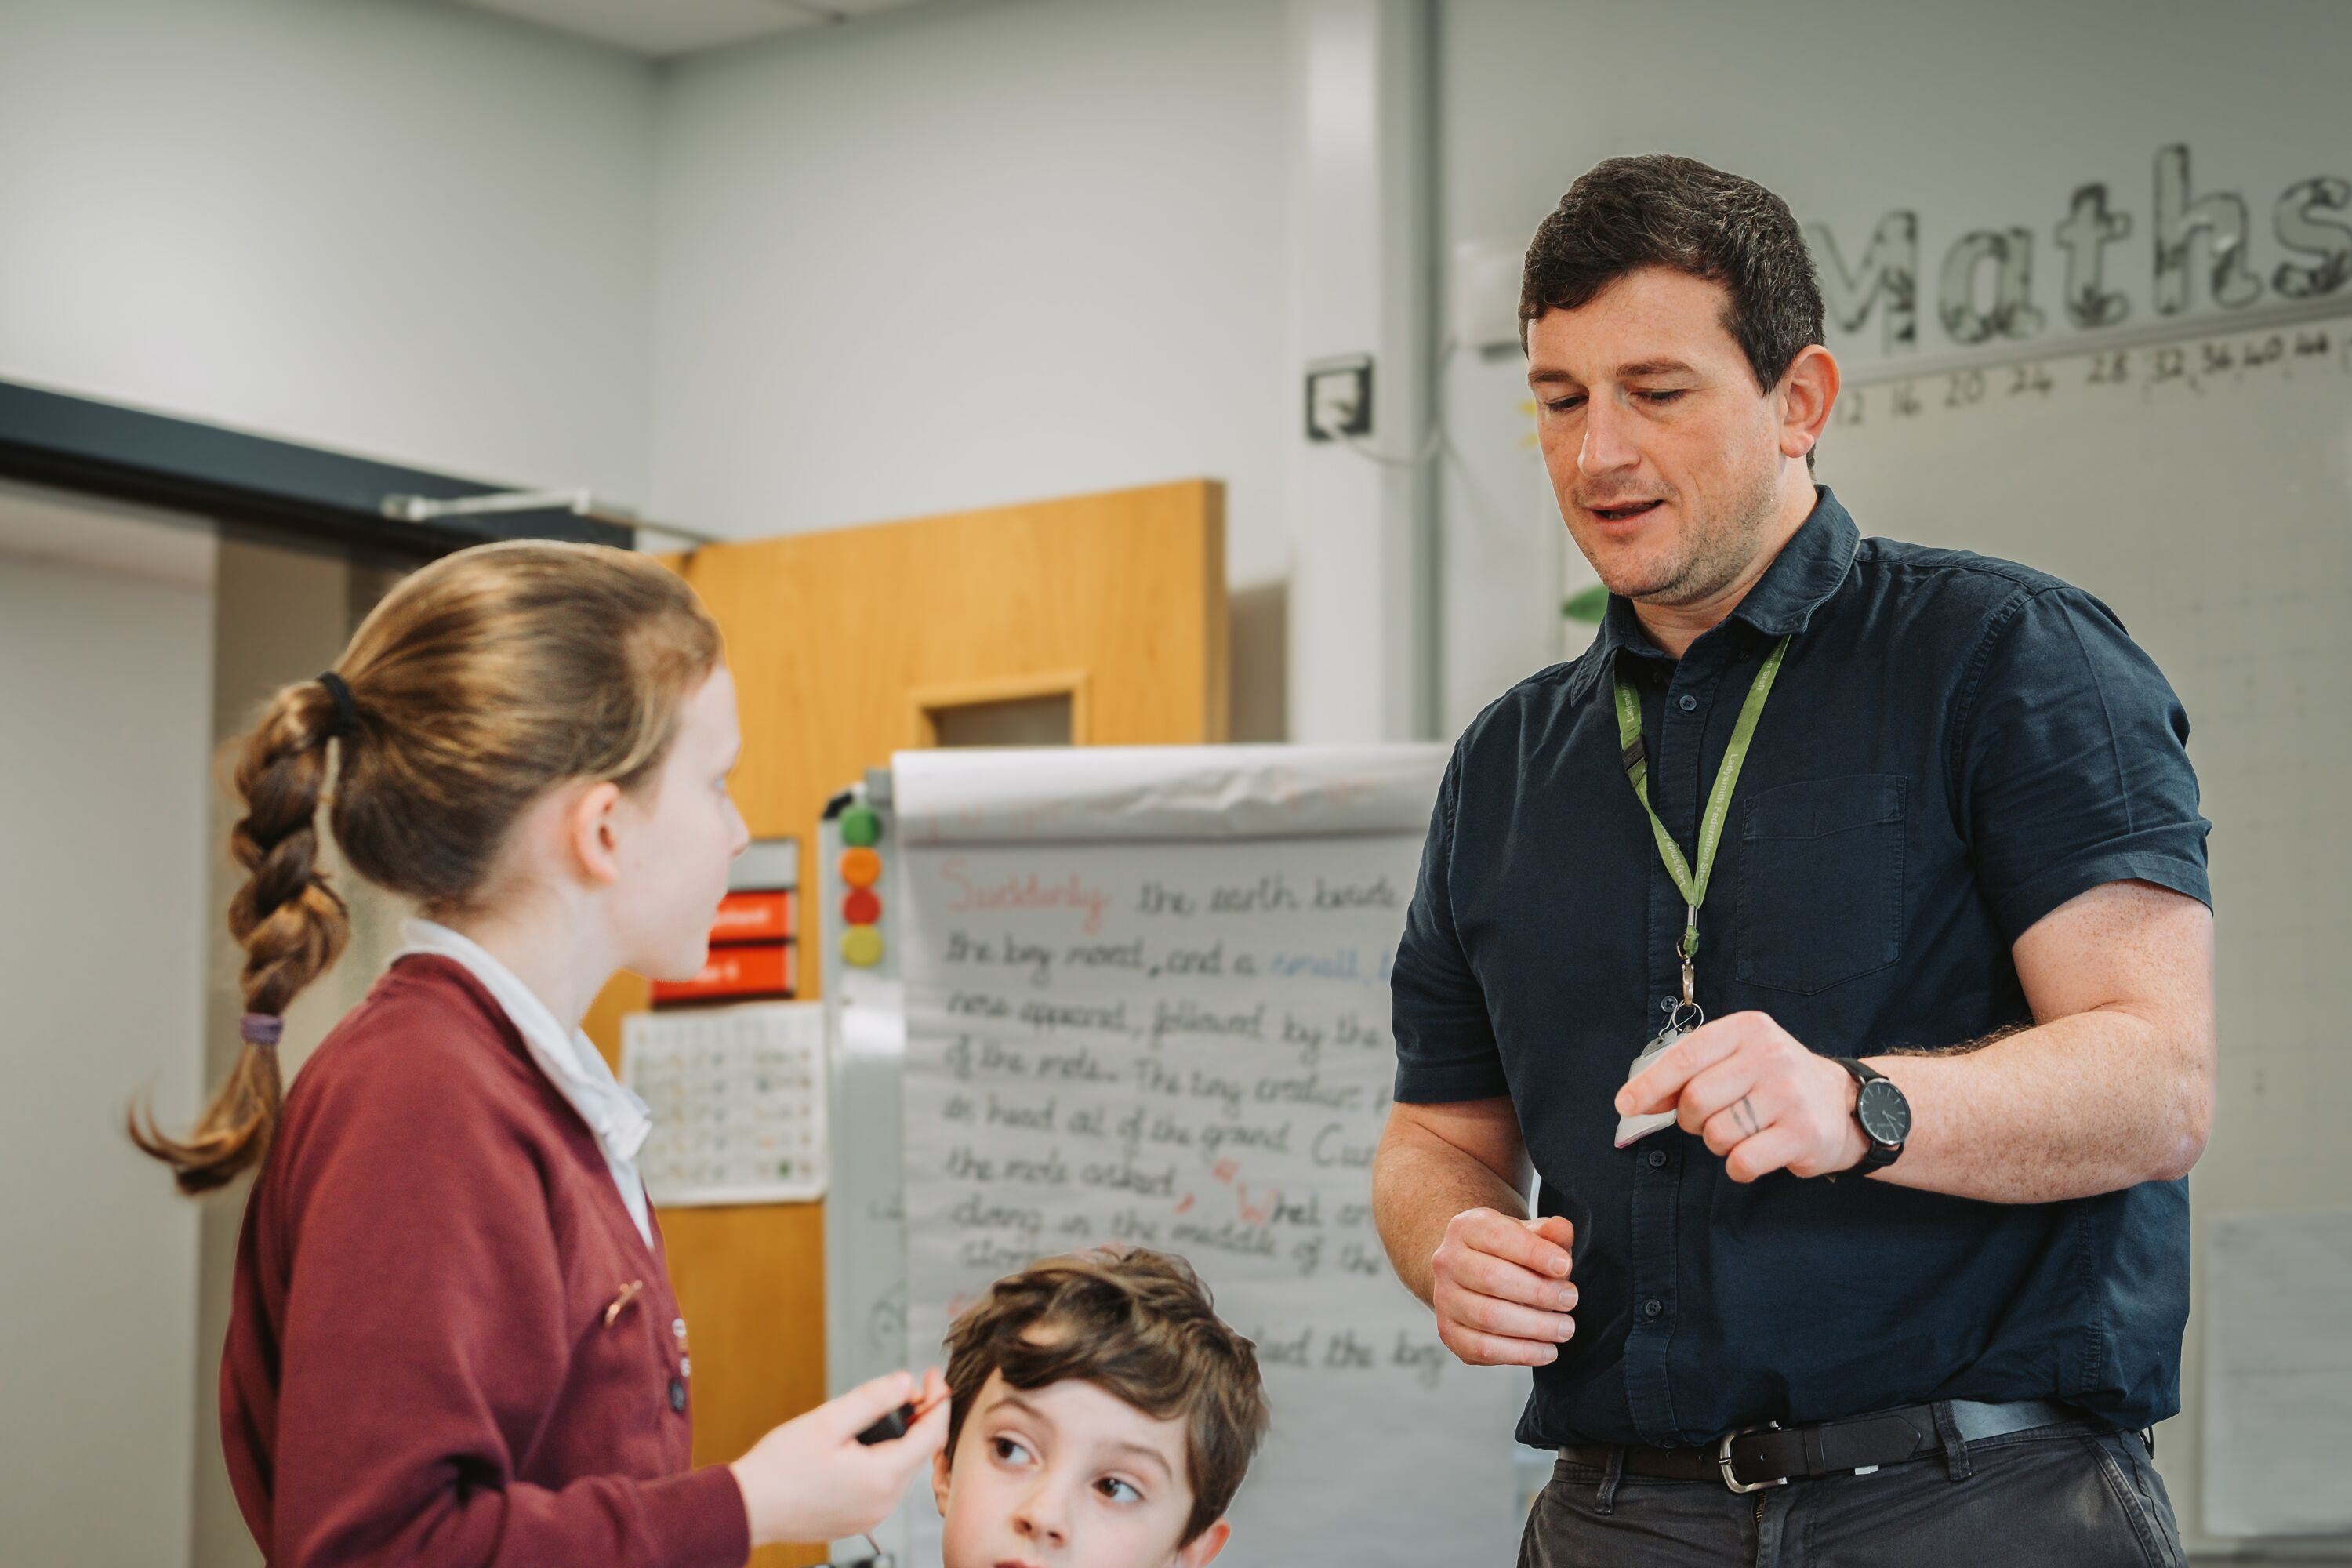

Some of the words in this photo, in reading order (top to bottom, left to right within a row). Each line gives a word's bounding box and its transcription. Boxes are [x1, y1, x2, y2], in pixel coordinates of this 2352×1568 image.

[1806, 143, 2352, 357] Maths
[1756, 670, 1771, 691] Staff
[1621, 688, 1635, 723] Ladysmith
[1715, 753, 1738, 804] Ladysmith
[1702, 806, 1722, 861] Federation
[1667, 841, 1686, 887] Ladysmith
[1136, 879, 1197, 917] the
[944, 930, 996, 965] the
[1166, 939, 1224, 977] and
[1232, 952, 1258, 977] a
[1283, 1011, 1323, 1067] by
